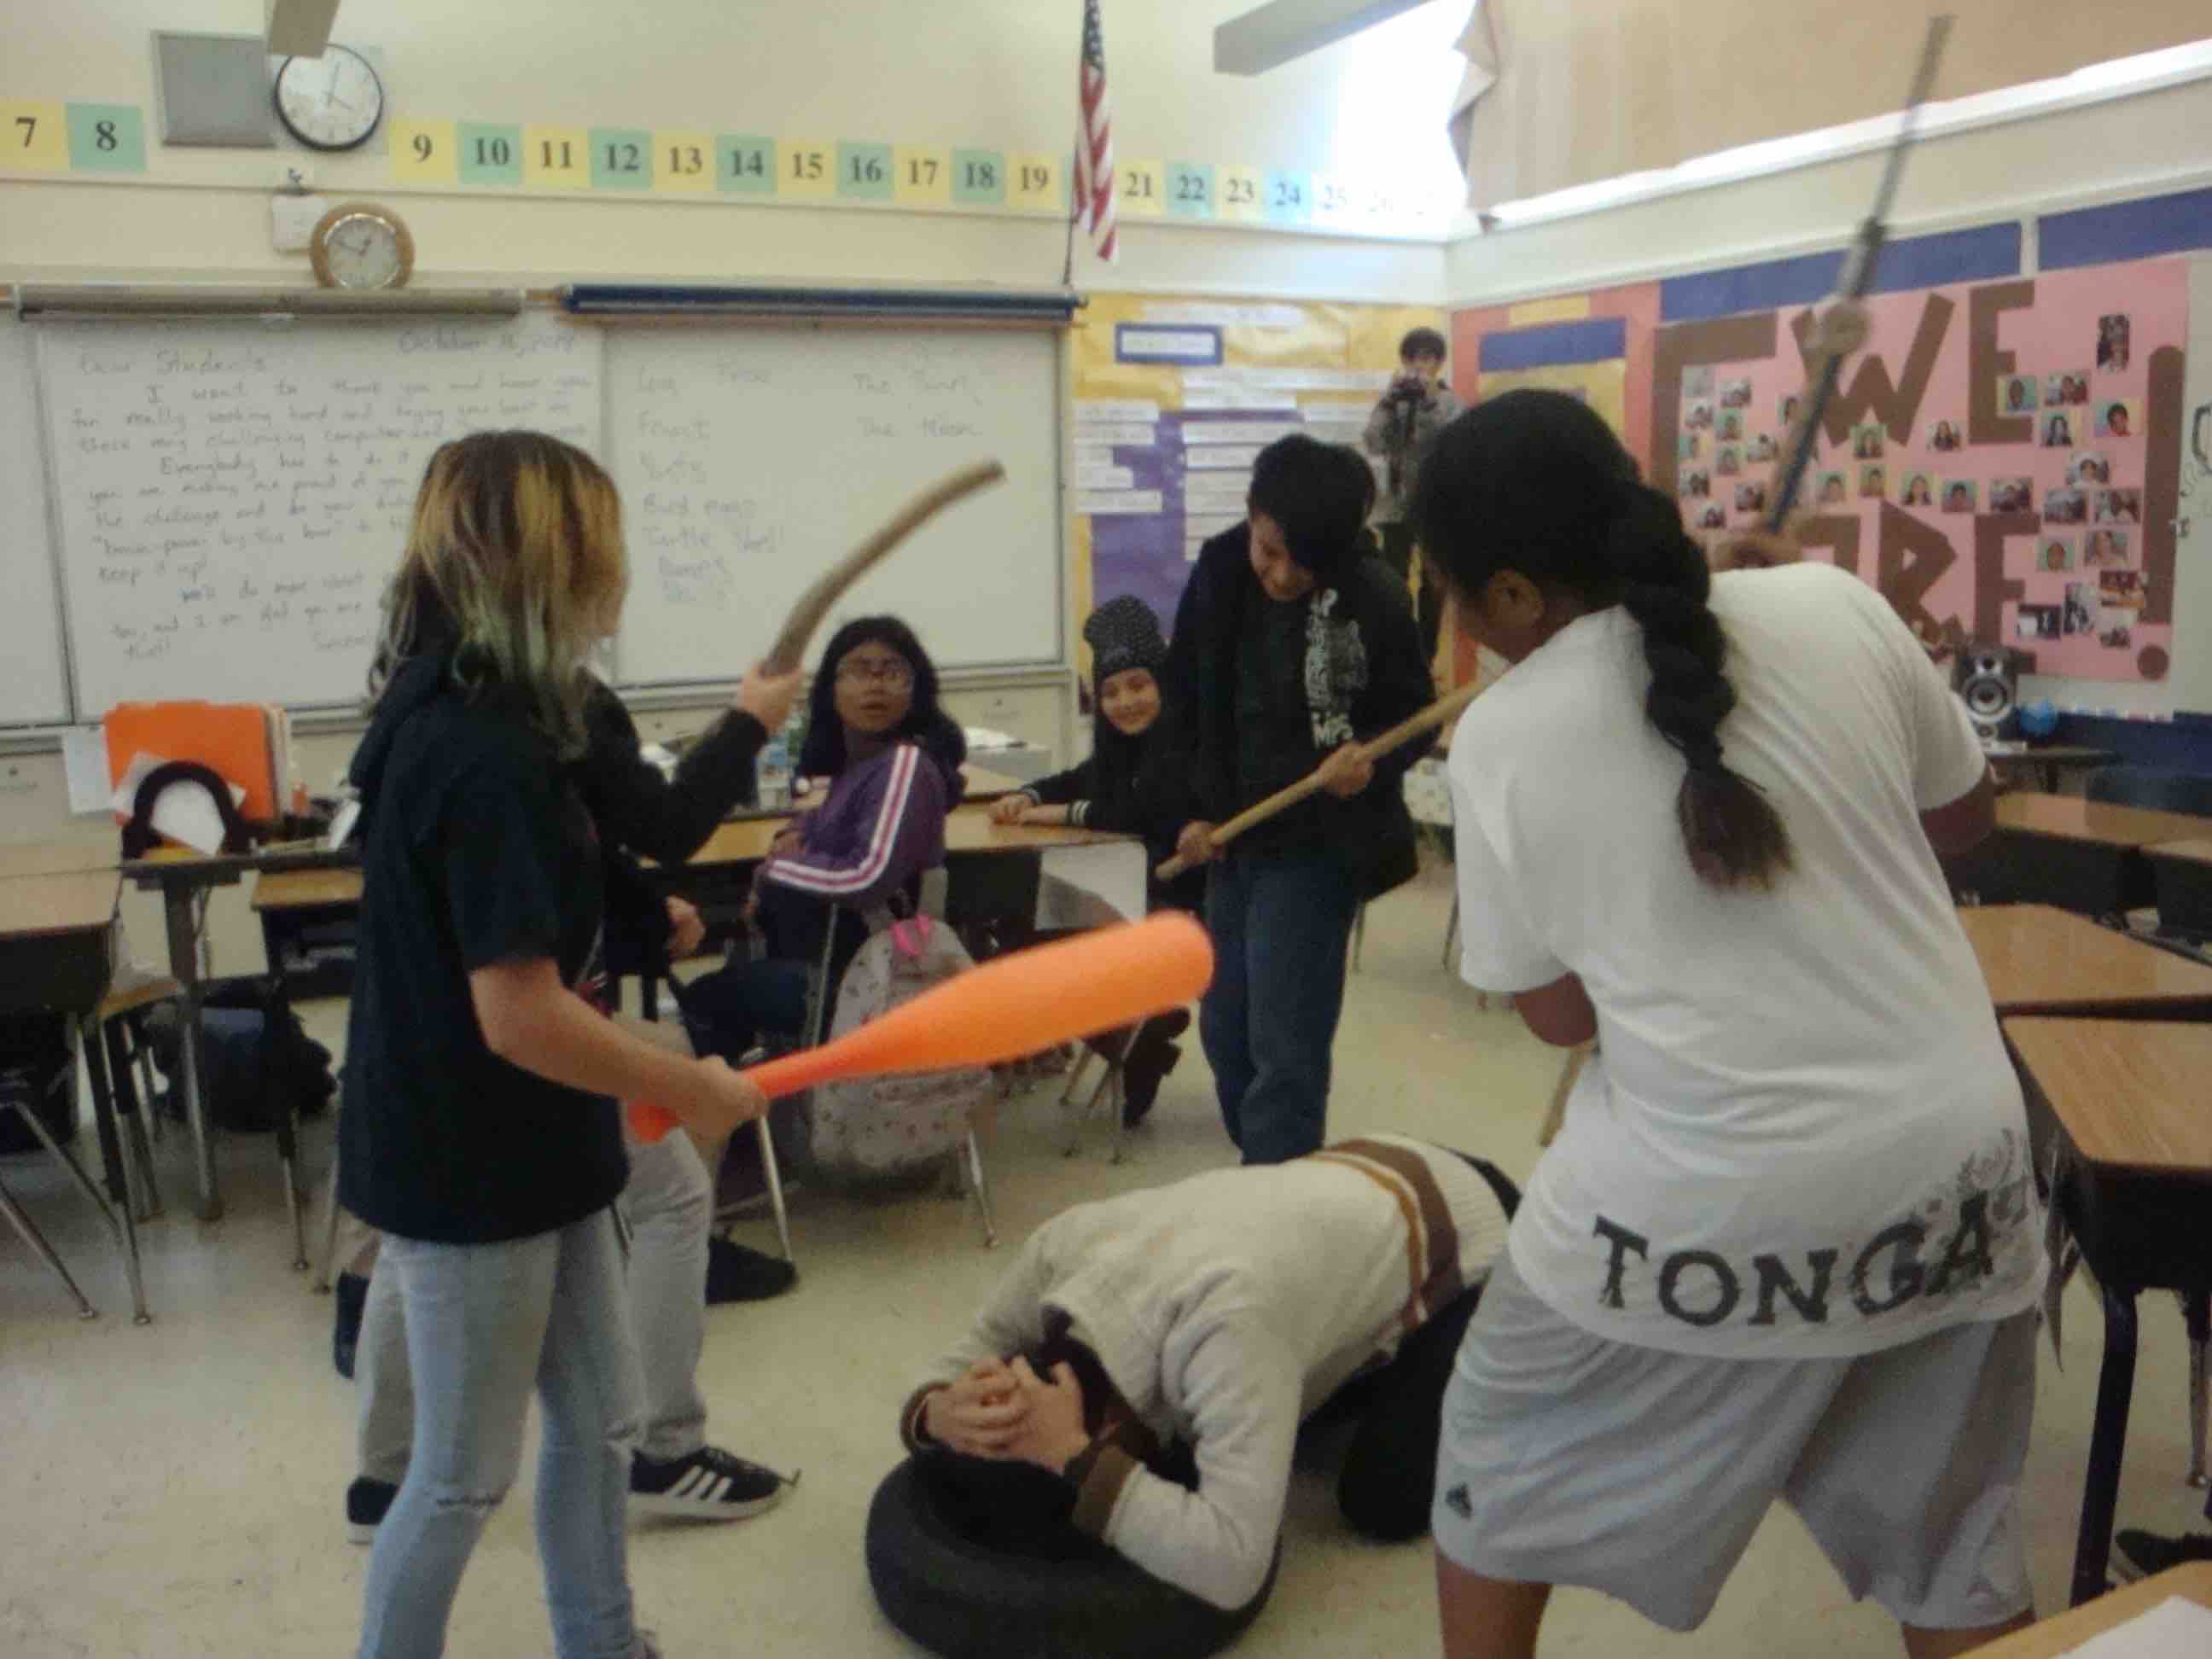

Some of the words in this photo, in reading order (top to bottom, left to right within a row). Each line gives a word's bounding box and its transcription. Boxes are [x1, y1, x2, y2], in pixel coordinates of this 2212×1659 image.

[15, 115, 37, 148] 7
[95, 119, 118, 152] 8
[412, 134, 433, 163] 9
[476, 137, 510, 166] 10
[542, 139, 572, 170] 11
[607, 142, 640, 172] 12
[670, 145, 703, 176] 13
[732, 148, 764, 177] 14
[793, 152, 823, 181] 15
[853, 154, 882, 183] 16
[909, 158, 938, 186] 17
[965, 161, 995, 189] 18
[1021, 165, 1049, 193] 19
[1125, 171, 1152, 198] 21
[1176, 173, 1204, 201] 22
[1225, 176, 1254, 204] 23
[1274, 180, 1301, 208] 24
[1790, 280, 2035, 446] WE
[1592, 1189, 1995, 1327] TONGA
